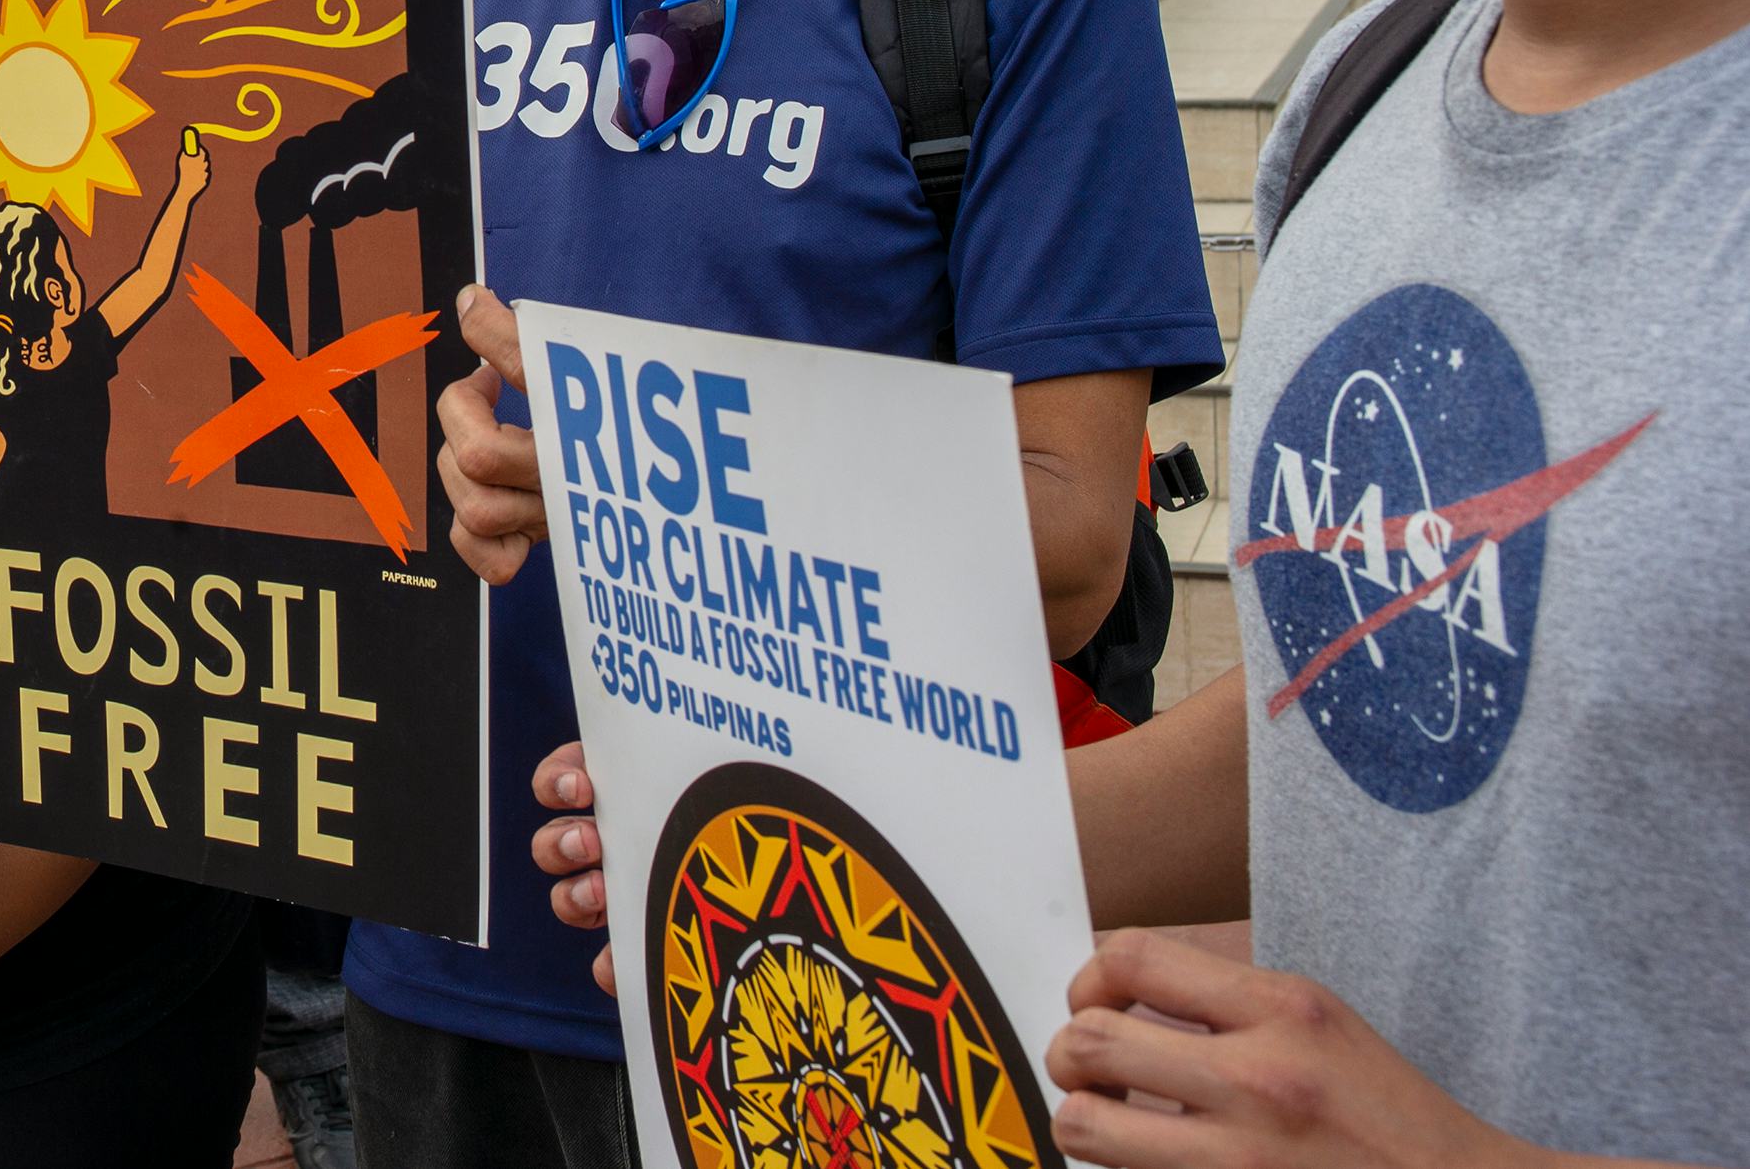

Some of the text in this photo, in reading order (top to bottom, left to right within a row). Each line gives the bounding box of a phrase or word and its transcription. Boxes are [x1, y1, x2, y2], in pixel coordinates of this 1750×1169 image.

[474, 19, 824, 190] 350.org
[545, 339, 769, 536] RISE
[382, 570, 438, 590] PAPERHAND
[567, 489, 891, 662] FOR CLIMATE
[1259, 441, 1518, 657] NASA
[580, 574, 1022, 763] TO BUILD A FOSSIL FREE WORLD
[596, 632, 793, 758] 350 PILIPINAS
[19, 687, 354, 867] FREE
